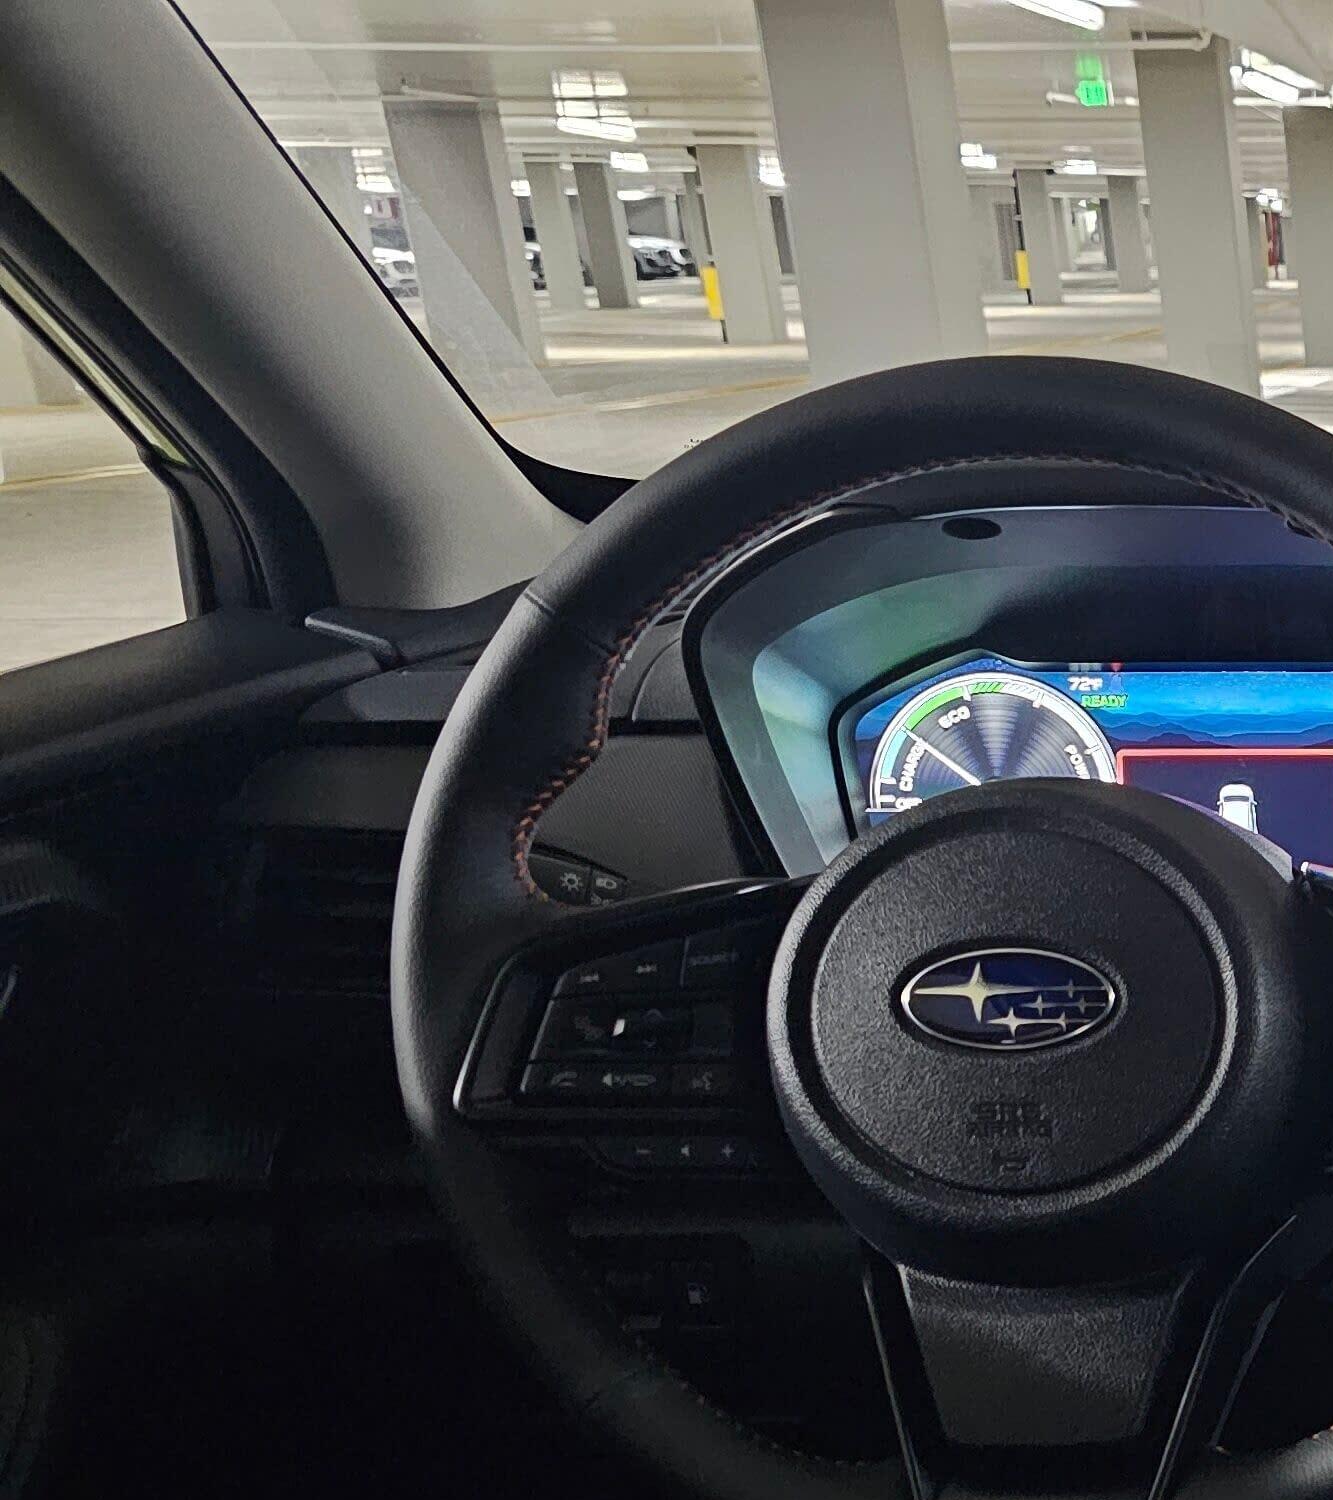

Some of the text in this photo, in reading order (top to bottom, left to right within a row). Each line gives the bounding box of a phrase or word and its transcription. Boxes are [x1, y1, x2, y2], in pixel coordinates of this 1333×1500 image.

[1081, 694, 1127, 708] READY
[938, 705, 971, 729] ECO
[1063, 744, 1091, 780] POW
